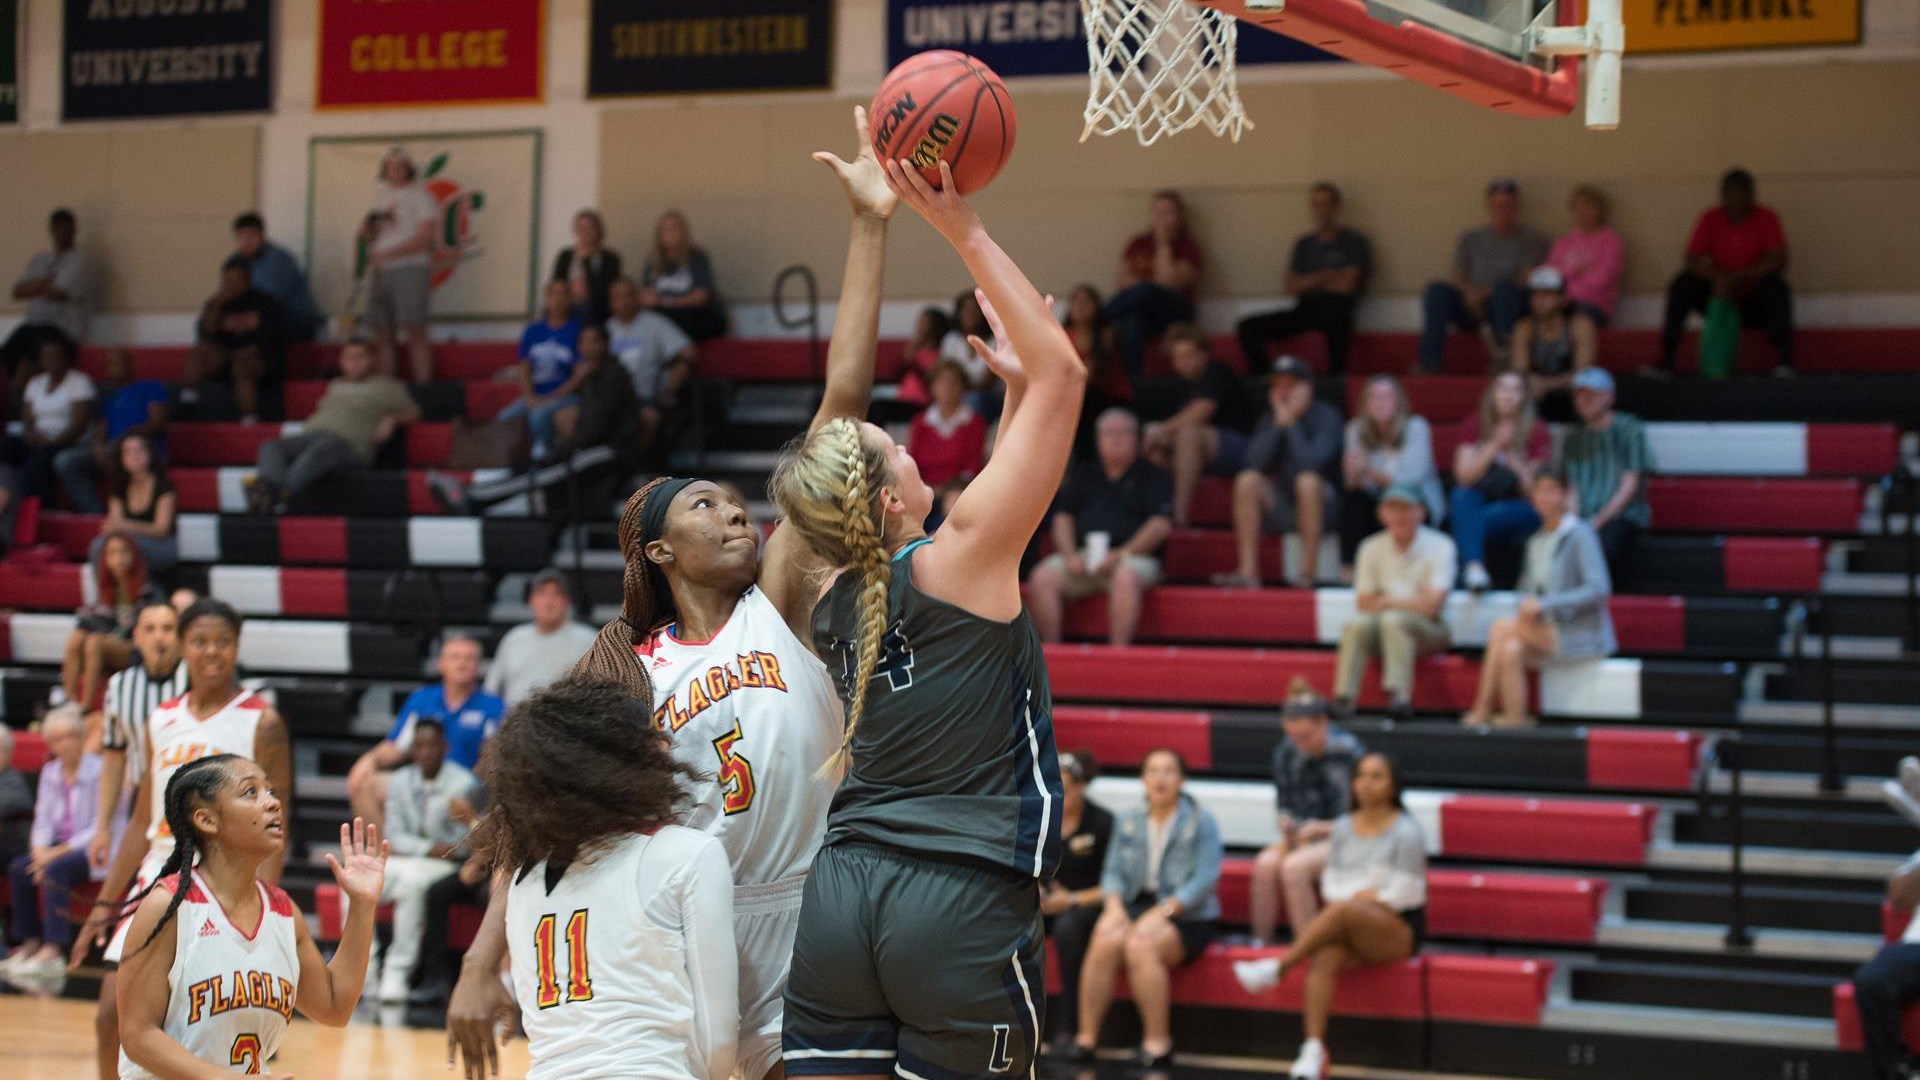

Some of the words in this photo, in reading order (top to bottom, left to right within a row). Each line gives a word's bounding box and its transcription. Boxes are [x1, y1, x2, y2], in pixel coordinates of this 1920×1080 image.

[351, 28, 508, 73] COLLEGE
[903, 1, 1138, 48] UNIVERSI
[71, 41, 264, 87] UNIVERSITY
[911, 111, 961, 169] Wils
[653, 650, 788, 733] FLAGLER
[711, 717, 756, 817] 5
[533, 907, 593, 1011] 11
[187, 970, 295, 1026] FLAGLE
[988, 1023, 1014, 1073] L
